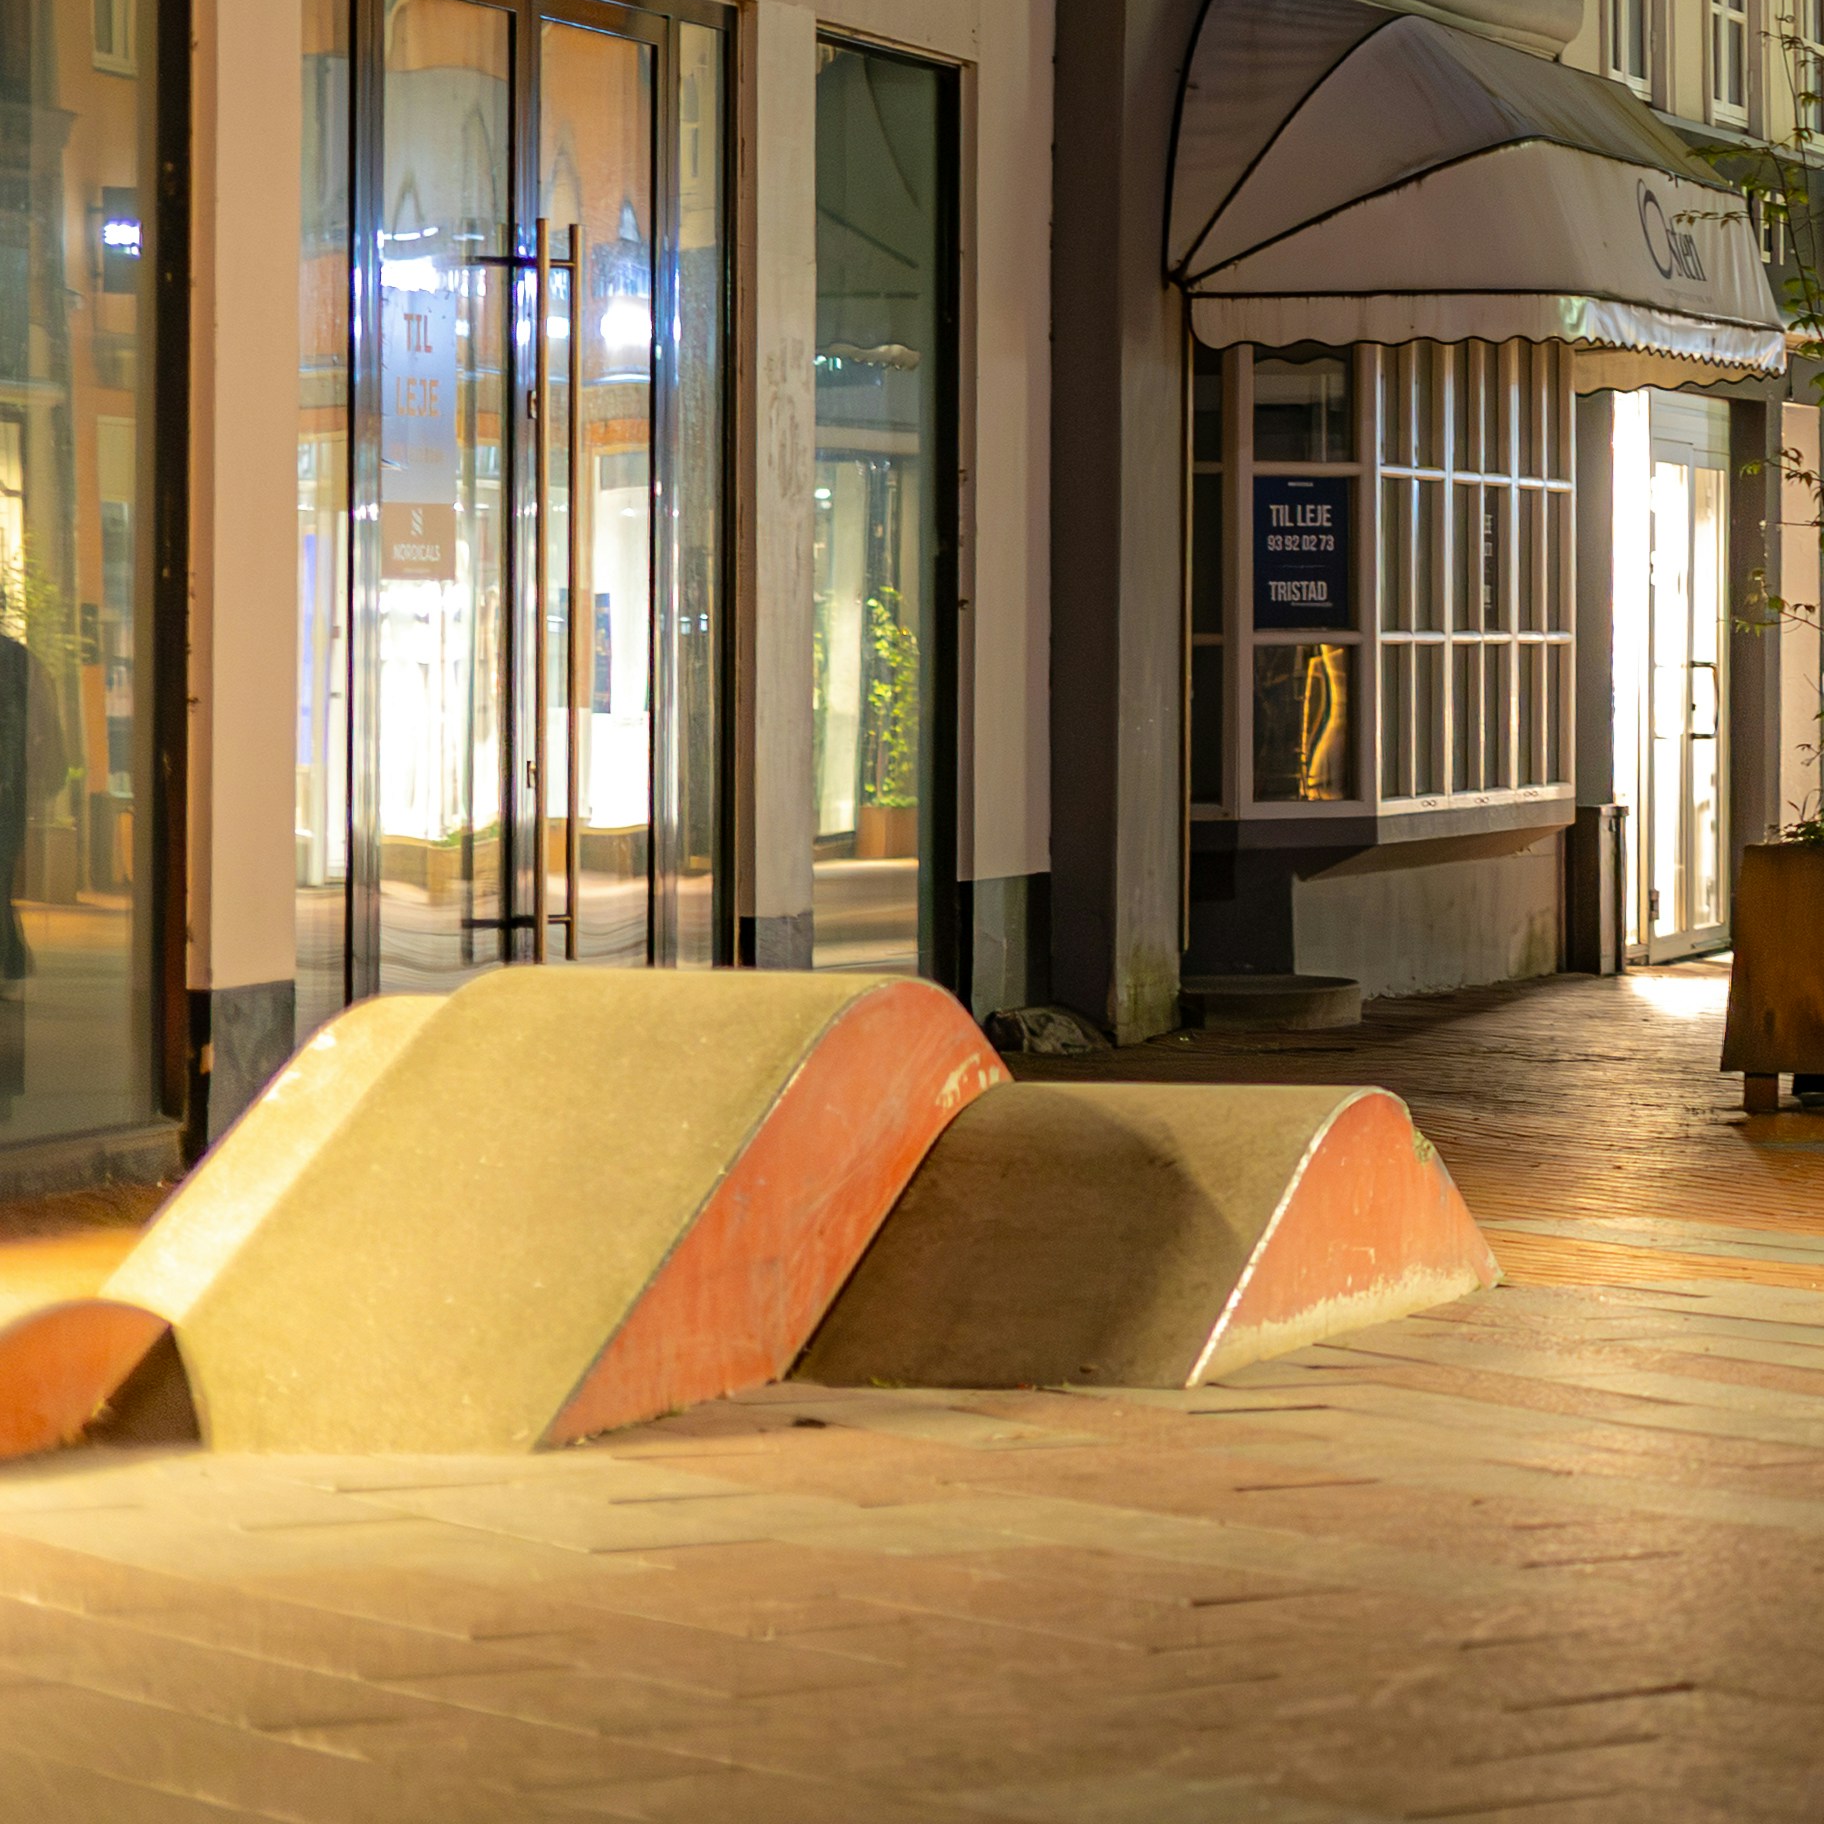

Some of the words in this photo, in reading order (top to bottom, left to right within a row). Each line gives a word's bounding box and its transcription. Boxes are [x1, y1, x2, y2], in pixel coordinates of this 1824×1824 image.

[403, 313, 432, 353] TIL
[395, 377, 440, 417] LEJE
[1269, 504, 1295, 527] TIL
[1296, 504, 1333, 527] LEJE
[1268, 580, 1328, 602] TRISTAD
